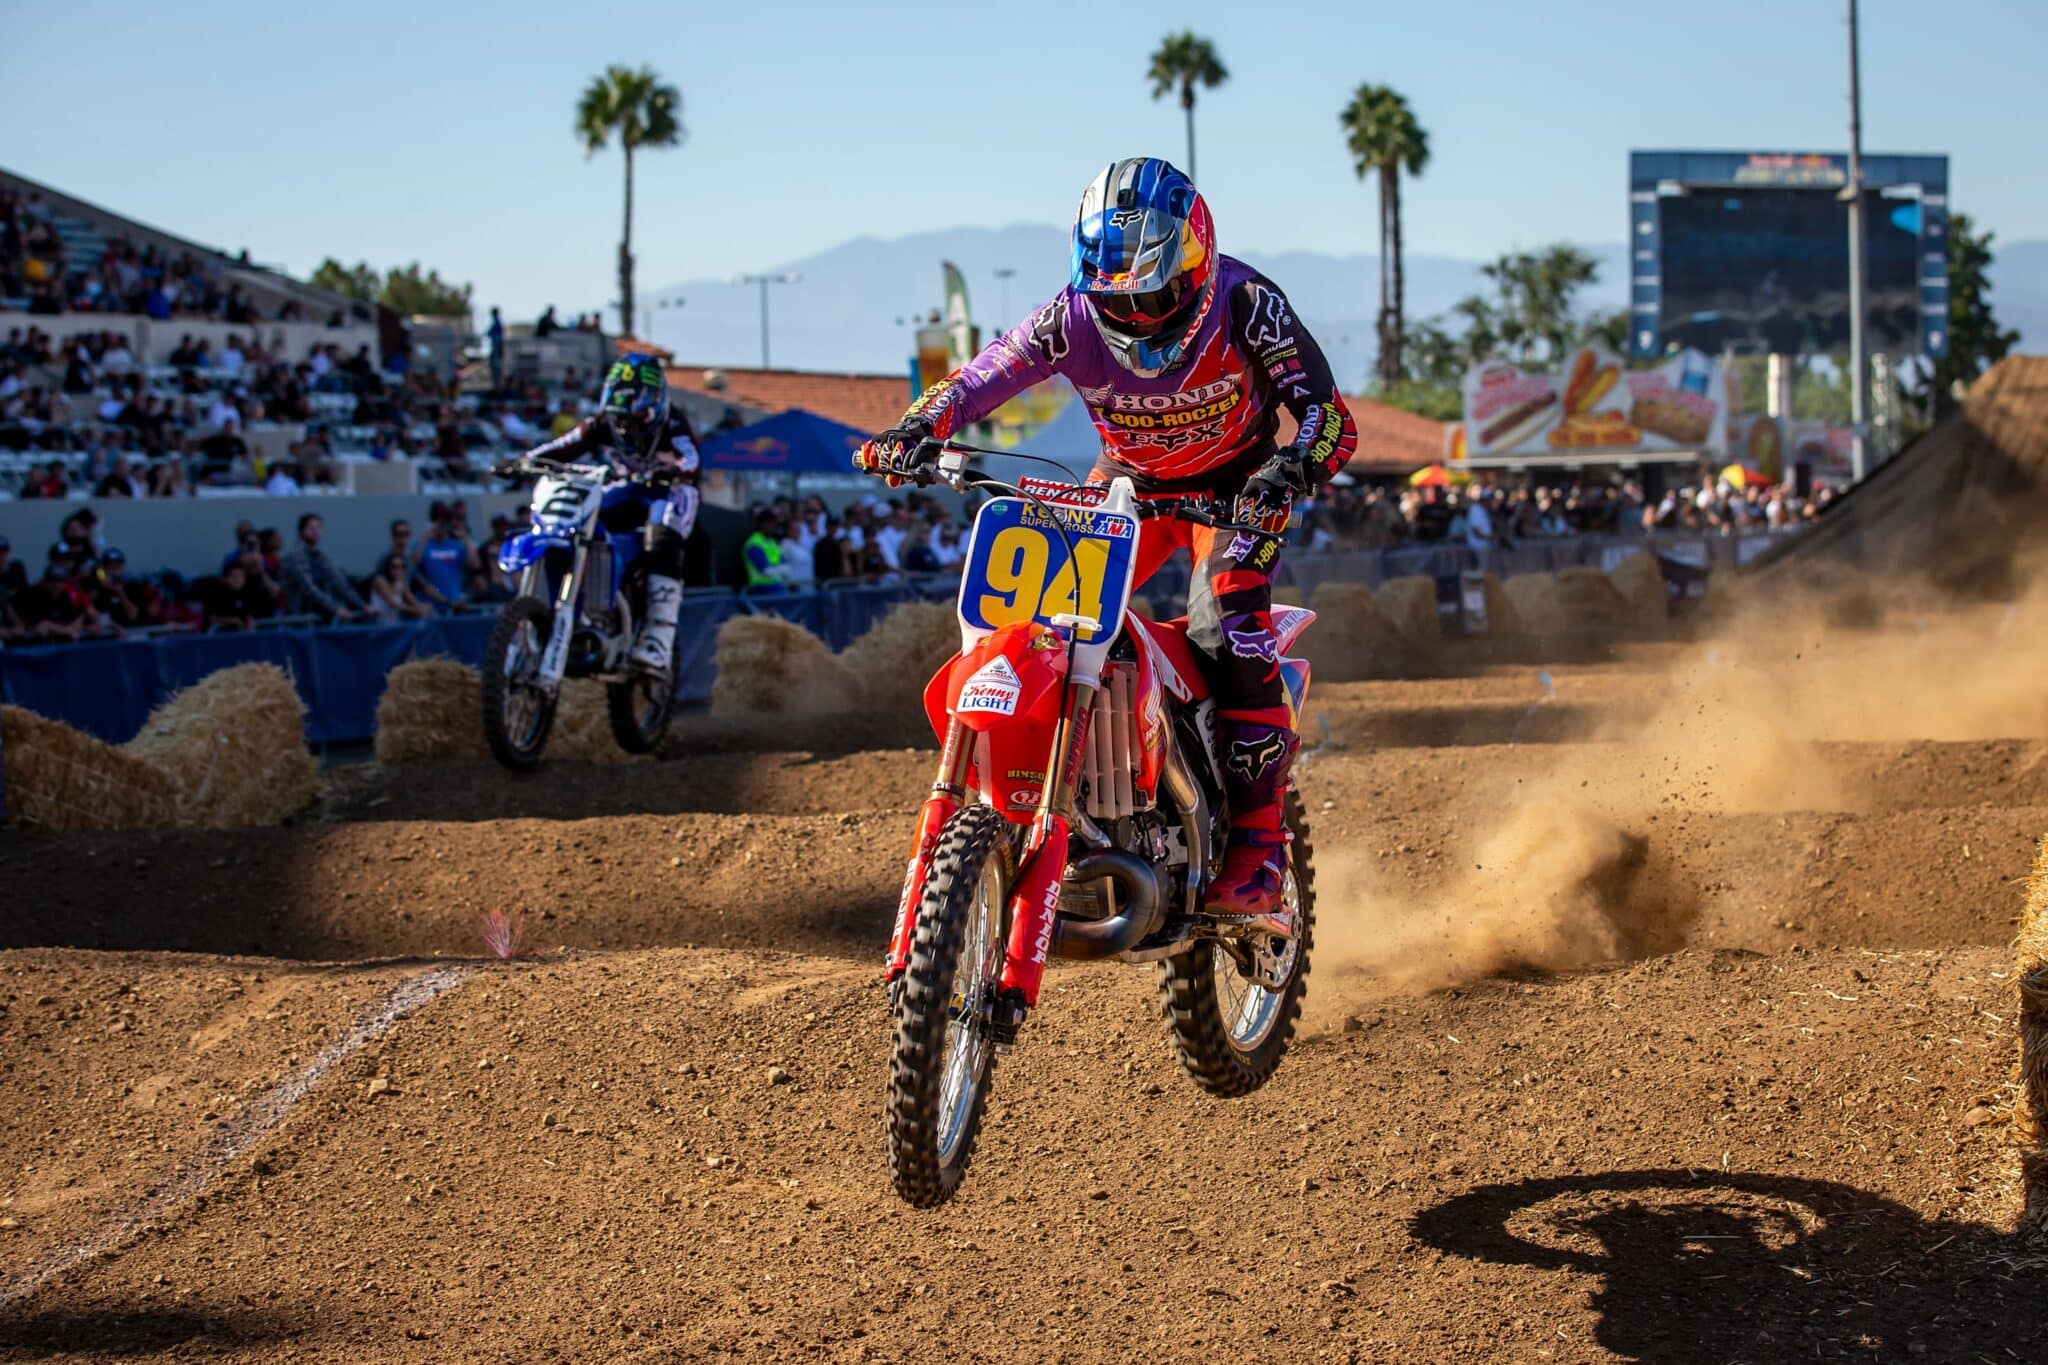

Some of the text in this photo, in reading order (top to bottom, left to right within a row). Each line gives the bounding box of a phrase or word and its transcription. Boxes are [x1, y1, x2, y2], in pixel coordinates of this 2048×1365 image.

[1112, 380, 1237, 411] HOND
[540, 485, 591, 519] 2
[1022, 502, 1097, 525] KENY
[1020, 516, 1095, 535] SUPERROSS
[1097, 521, 1133, 538] AMA
[979, 526, 1111, 641] 94
[964, 684, 1015, 703] Kenny
[961, 696, 1013, 711] LIGHT
[1007, 769, 1045, 781] HINSO
